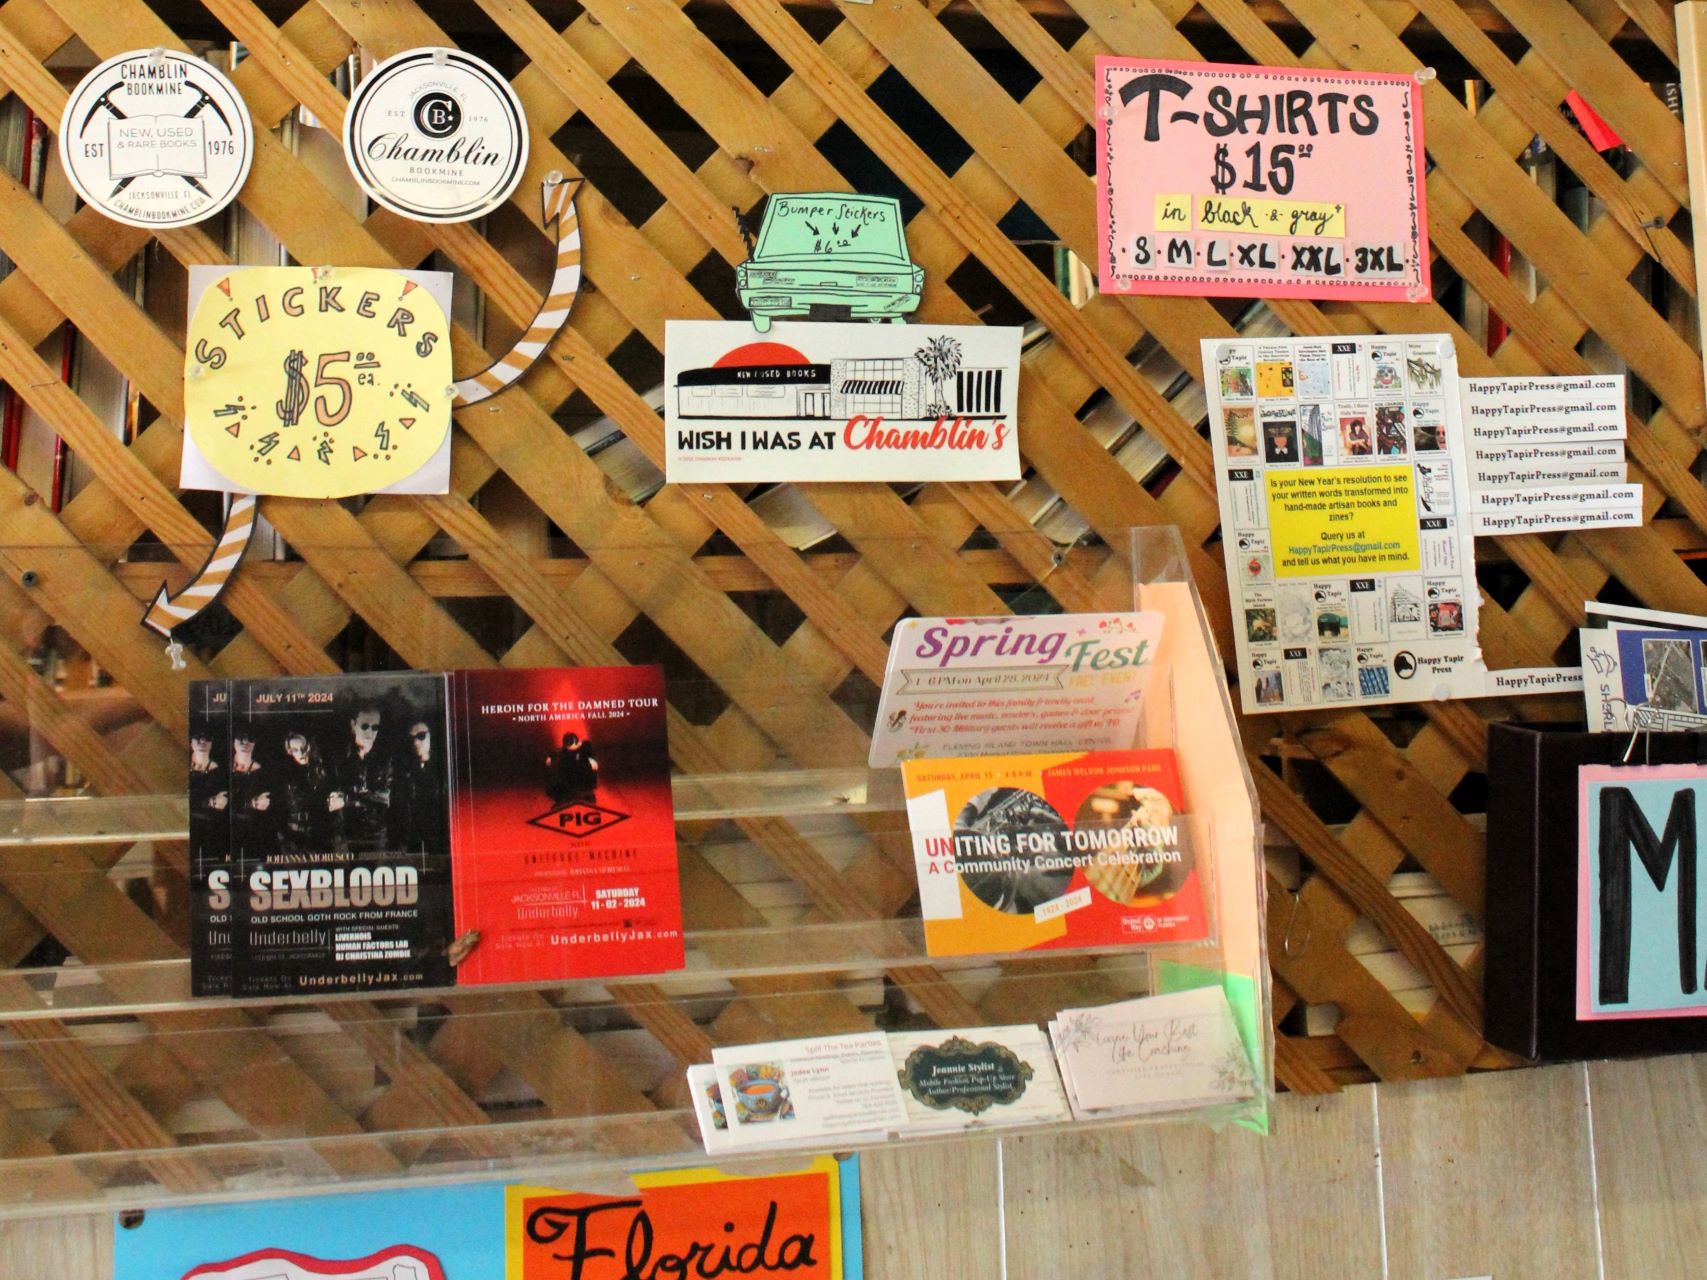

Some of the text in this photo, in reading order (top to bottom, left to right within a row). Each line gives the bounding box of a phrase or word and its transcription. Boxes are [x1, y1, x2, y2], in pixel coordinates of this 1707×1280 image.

[120, 64, 188, 80] CHAMBLIN
[127, 82, 182, 96] BOOKMINE
[387, 110, 406, 118] EST
[1118, 73, 1380, 142] T-SHIRTS
[468, 116, 488, 124] 1976
[156, 127, 193, 138] USED
[84, 143, 105, 158] EST
[117, 139, 197, 149] & RARE BOOKS
[207, 140, 235, 156] 1976
[367, 132, 504, 167] Chamblin
[409, 166, 464, 177] BOOKMINE
[777, 200, 887, 226] Bumper Stickers
[1161, 200, 1187, 223] in
[1200, 199, 1259, 228] black
[1134, 236, 1404, 275] S M L XL XXL 3XL
[195, 287, 438, 370] STICKERS
[1469, 380, 1616, 395] HappyTapirPress@gmail.com
[1471, 402, 1617, 417] HappyTapirPress@gmail.com
[678, 414, 1012, 452] WISH I WAS AT Chamblin's
[1473, 423, 1618, 439] HappyTapirPress@gmail.com
[1475, 447, 1617, 462] HappyTapirPress@gmail.com
[1270, 479, 1278, 487] Is
[1280, 479, 1297, 489] your
[1298, 478, 1315, 486] New
[1317, 477, 1341, 486] Year's
[1343, 475, 1382, 484] resolution
[1394, 474, 1408, 482] see
[1478, 469, 1620, 484] HappyTapirPress@gmail.com
[1271, 486, 1409, 501] your written words transformed into
[1481, 490, 1634, 507] HappyTapirPress@gmail.com
[1284, 498, 1397, 512] hand-made artisan books and
[1329, 512, 1354, 521] zines?
[1482, 512, 1634, 528] HappyTapirPress@gmail.com
[1320, 531, 1344, 541] Query
[1288, 542, 1400, 555] HappyTapirPress@gmail.com
[1282, 552, 1410, 567] and tell us what you have in mind.
[915, 626, 1067, 667] Spring
[1065, 639, 1149, 673] Fest
[1417, 655, 1464, 665] Happy Tapir
[1432, 666, 1452, 674] Press
[255, 693, 282, 703] JULY
[308, 693, 333, 703] 2024
[482, 698, 659, 715] HEROIN FOR THE DAMNED TOUR
[518, 714, 546, 723] NORTH
[549, 713, 585, 721] AMERICA
[609, 710, 625, 718] 2024
[559, 812, 602, 827] PIG
[925, 826, 1178, 857] UNITING FOR TOMORROW
[928, 848, 1182, 875] A Community Concert Celebration
[249, 866, 419, 912] SEXBLOOD
[595, 887, 639, 899] SATURDAY
[1600, 786, 1707, 1006] M
[250, 909, 418, 924] OLD SCHOOL GOTH ROCK FROM FRANCE
[517, 906, 579, 920] Underbelly
[249, 929, 326, 945] Underbelly
[551, 930, 678, 945] UnderbellyJax.com
[299, 972, 423, 987] UnderbellyJax.com
[968, 1061, 995, 1074] Stylist
[526, 1199, 817, 1280] Florida
